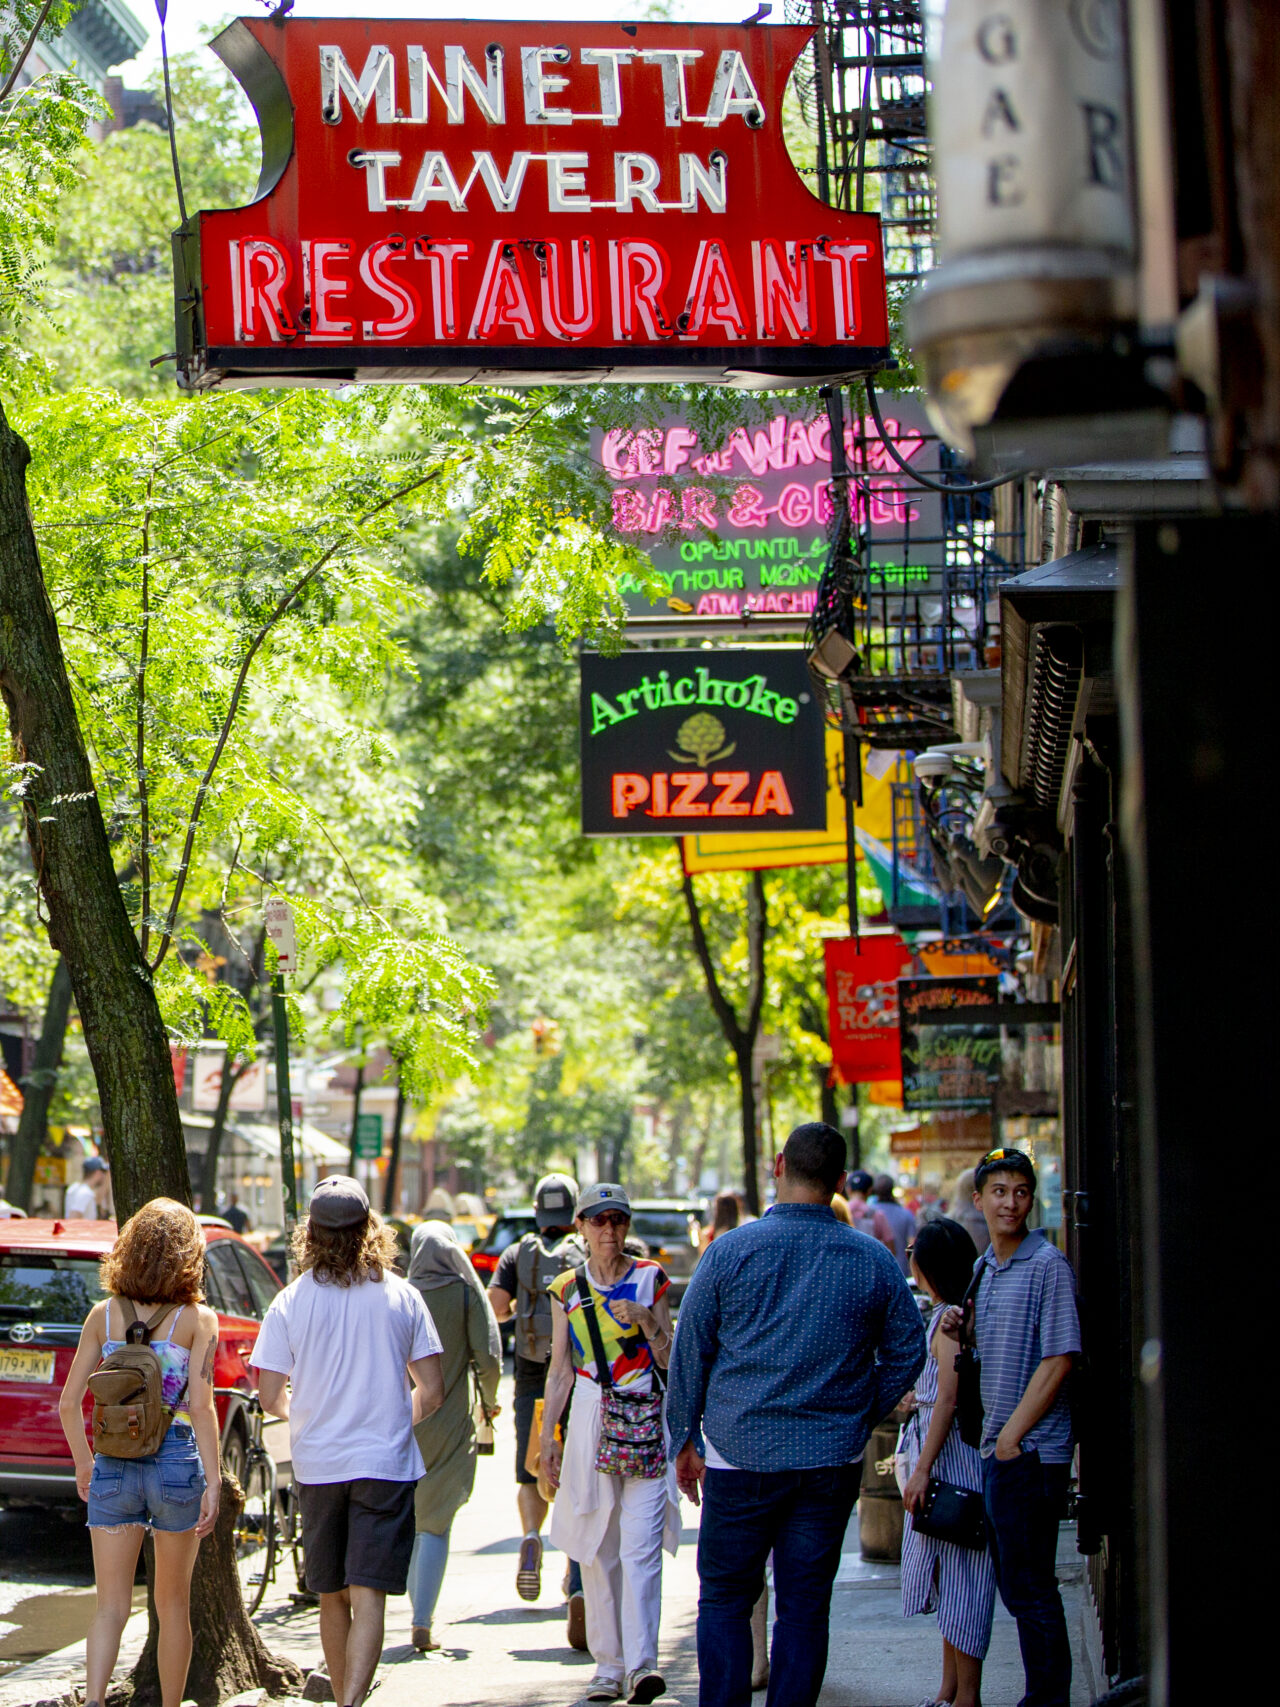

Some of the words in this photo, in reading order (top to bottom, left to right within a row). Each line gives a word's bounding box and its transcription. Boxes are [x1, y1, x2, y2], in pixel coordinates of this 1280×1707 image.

[319, 45, 766, 126] MINETTA
[354, 150, 728, 213] TAVERN
[228, 236, 875, 342] RESTAURANT
[611, 486, 719, 534] BAR
[590, 667, 800, 734] Artichoke
[612, 770, 794, 818] PIZZA
